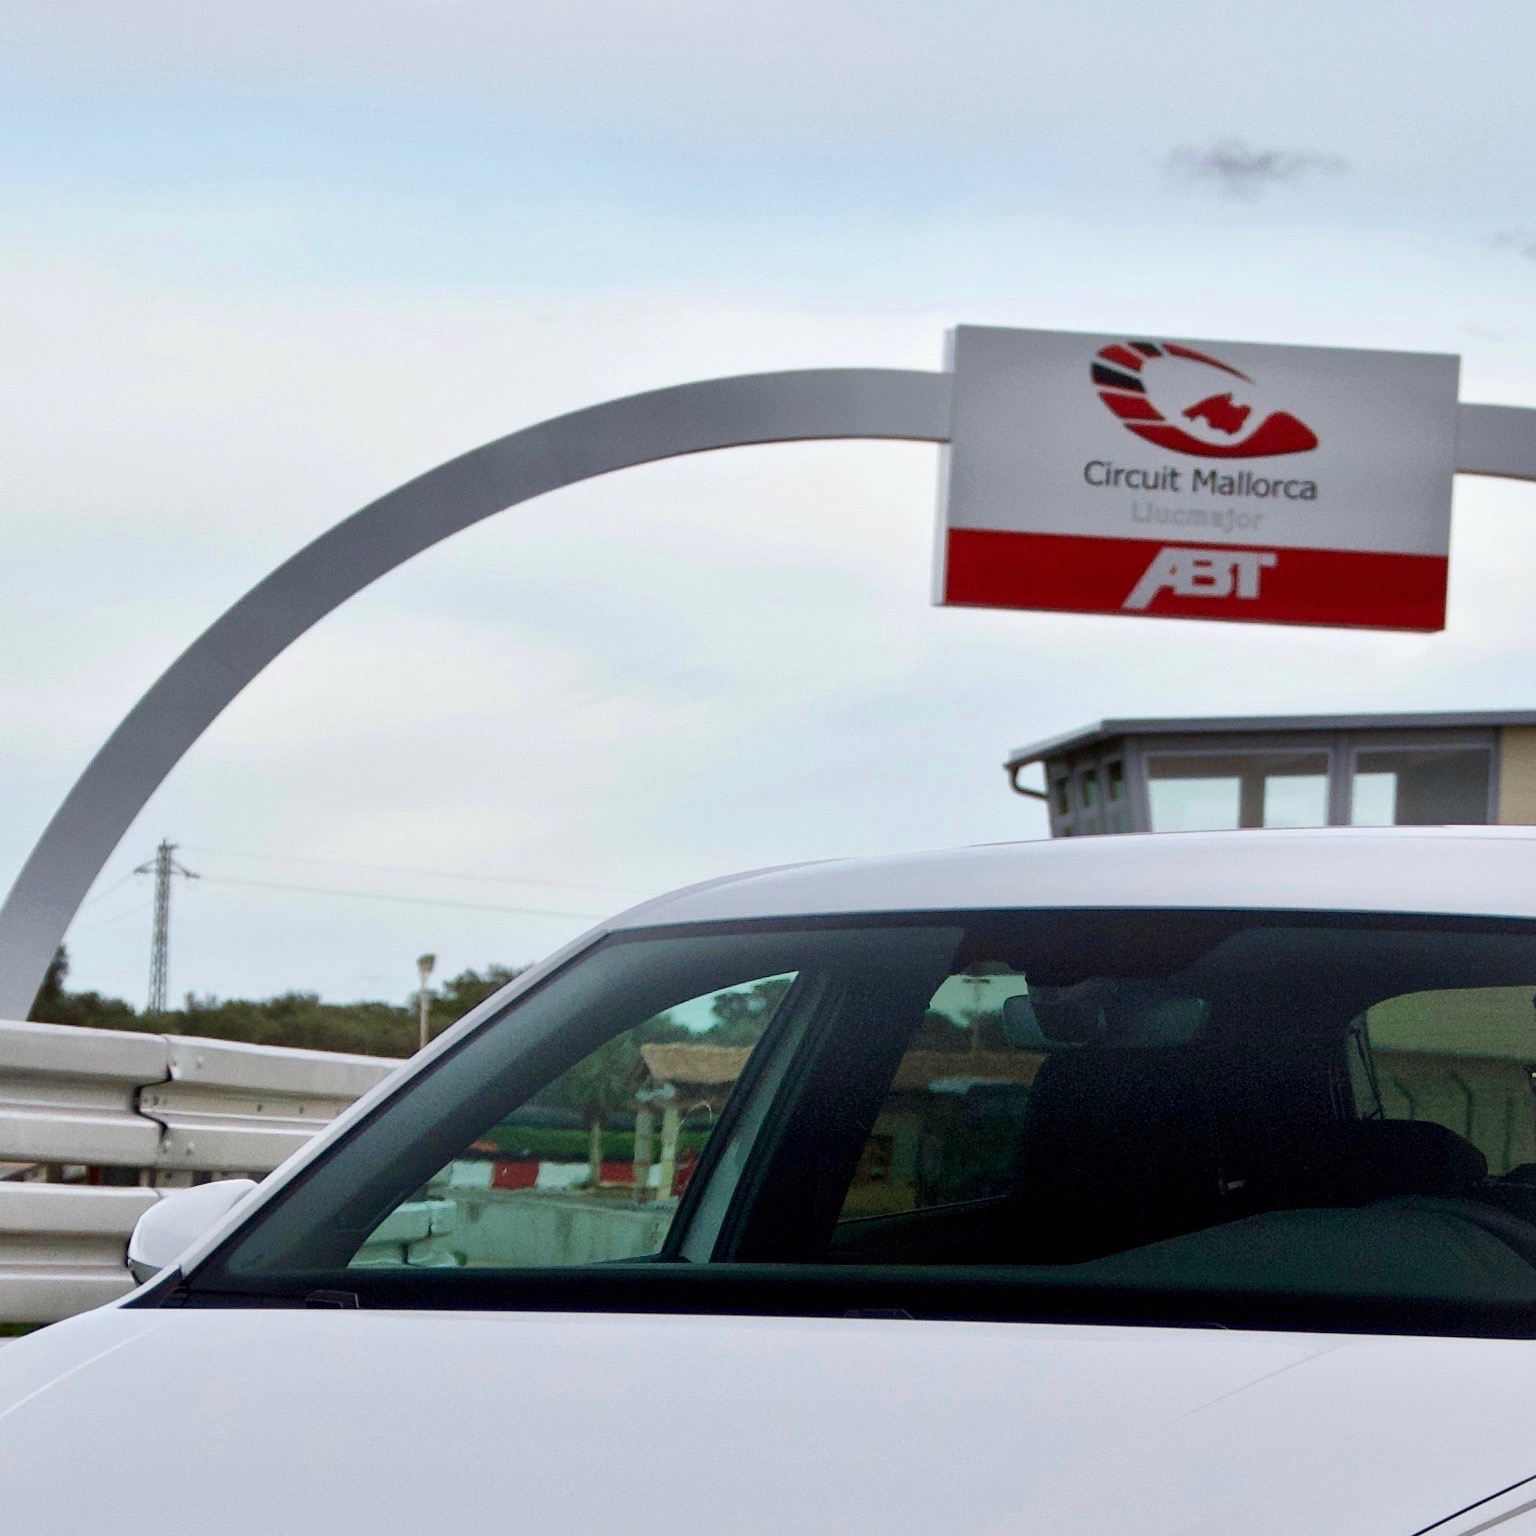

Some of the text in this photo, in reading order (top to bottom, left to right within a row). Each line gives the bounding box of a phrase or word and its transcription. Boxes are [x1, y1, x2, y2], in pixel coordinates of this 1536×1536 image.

[1083, 459, 1318, 501] Circuit Mallorca
[1120, 546, 1279, 610] ABT
